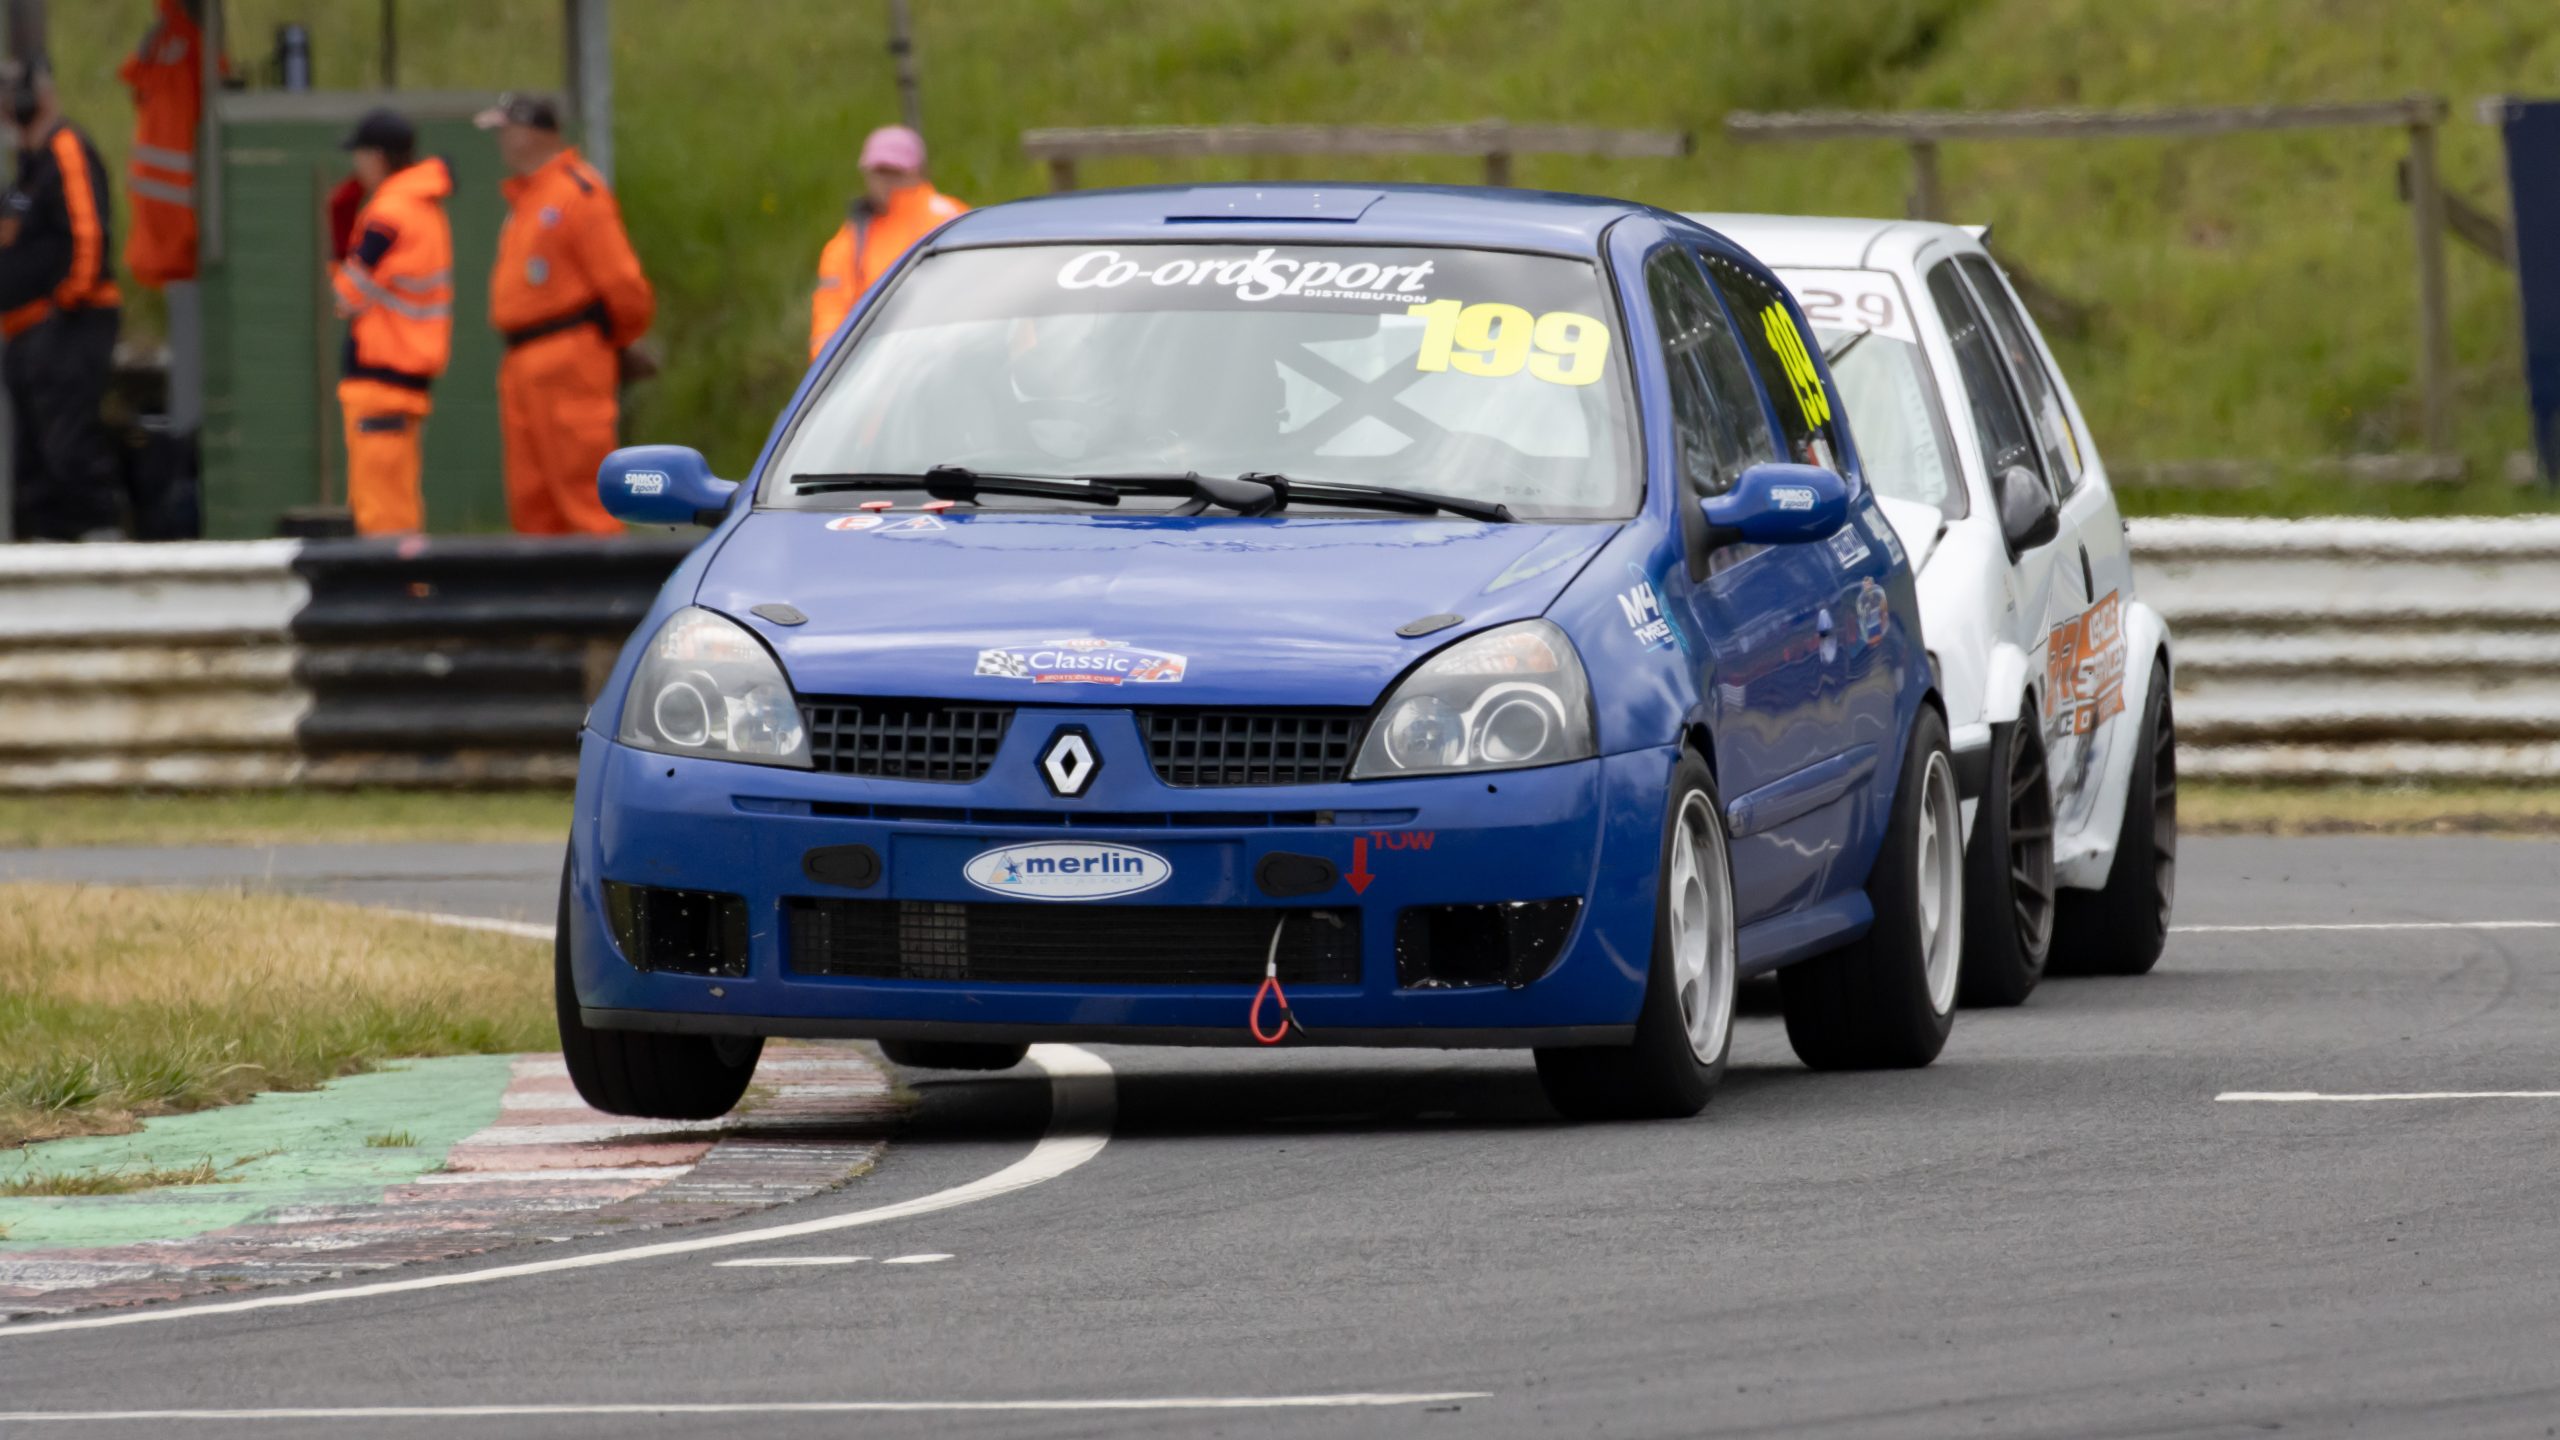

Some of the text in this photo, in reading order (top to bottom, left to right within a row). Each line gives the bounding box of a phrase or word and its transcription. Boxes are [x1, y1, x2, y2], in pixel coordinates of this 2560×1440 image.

[1303, 288, 1428, 304] DISTRIBUTION
[1407, 299, 1610, 386] 199
[1760, 301, 1831, 432] 199
[624, 473, 662, 485] SAMCO
[633, 483, 661, 494] sport
[1617, 581, 1660, 628] M4
[1633, 618, 1671, 646] TYRES
[1029, 651, 1130, 672] Classic
[1369, 831, 1435, 851] TOW
[1026, 852, 1144, 875] merlin
